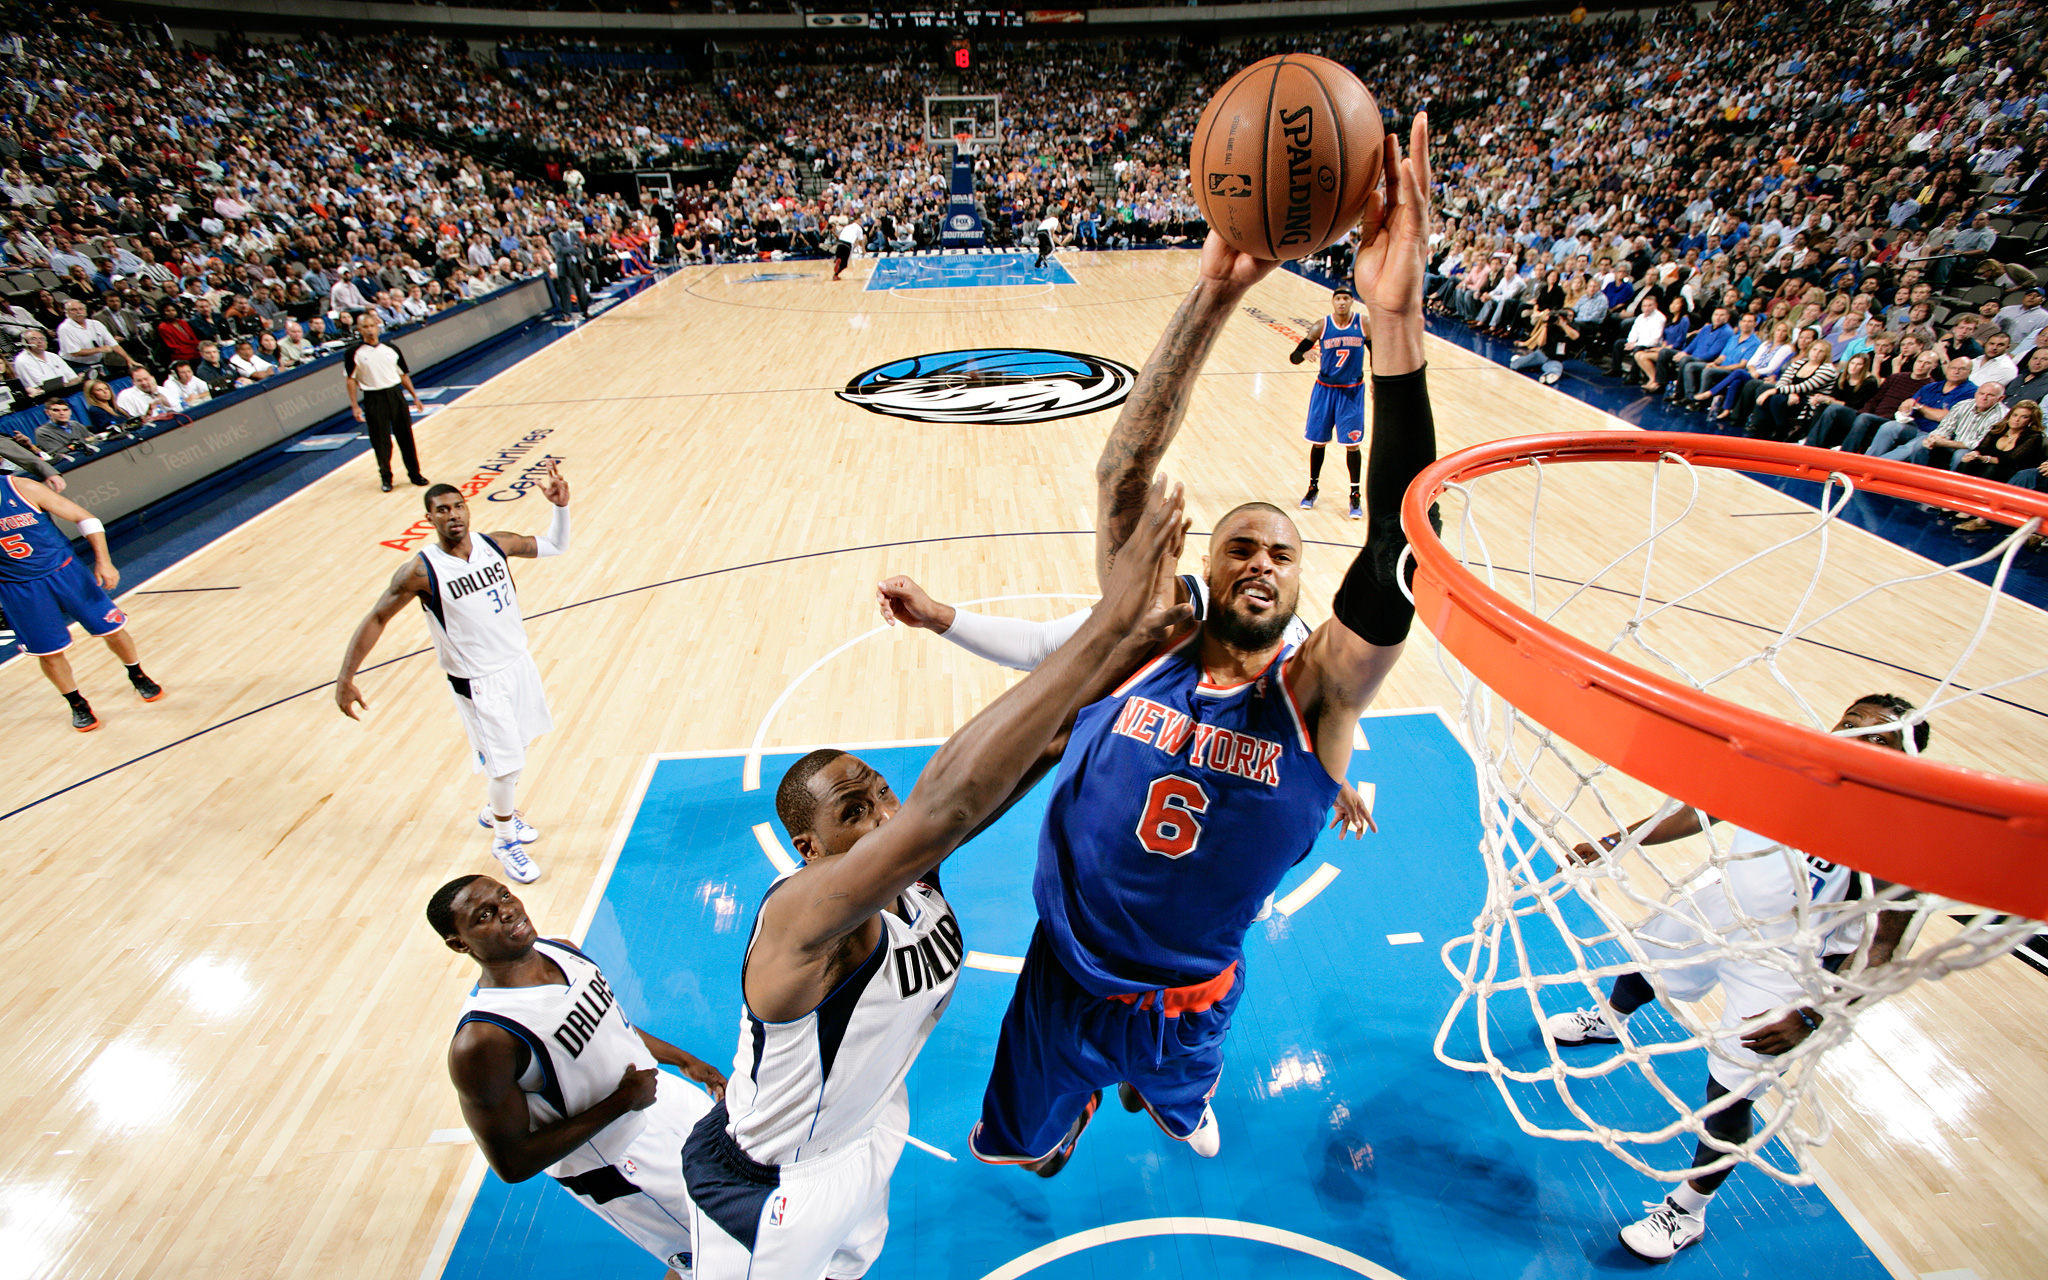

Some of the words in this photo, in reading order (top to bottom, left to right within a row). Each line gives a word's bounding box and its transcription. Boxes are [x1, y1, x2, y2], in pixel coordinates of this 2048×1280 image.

[914, 16, 931, 27] 104
[967, 16, 979, 26] 95
[955, 48, 970, 68] 18
[1227, 137, 1235, 152] GAME
[1278, 105, 1314, 249] SPALDING
[943, 231, 984, 239] SOUTHWEST
[1335, 349, 1350, 367] 7
[0, 533, 34, 559] 5
[446, 562, 506, 600] DALLAS
[486, 583, 511, 614] 32
[1111, 695, 1199, 757] NEW
[1189, 723, 1283, 788] YORK
[1135, 773, 1210, 860] 6
[893, 914, 964, 1001] DALLA
